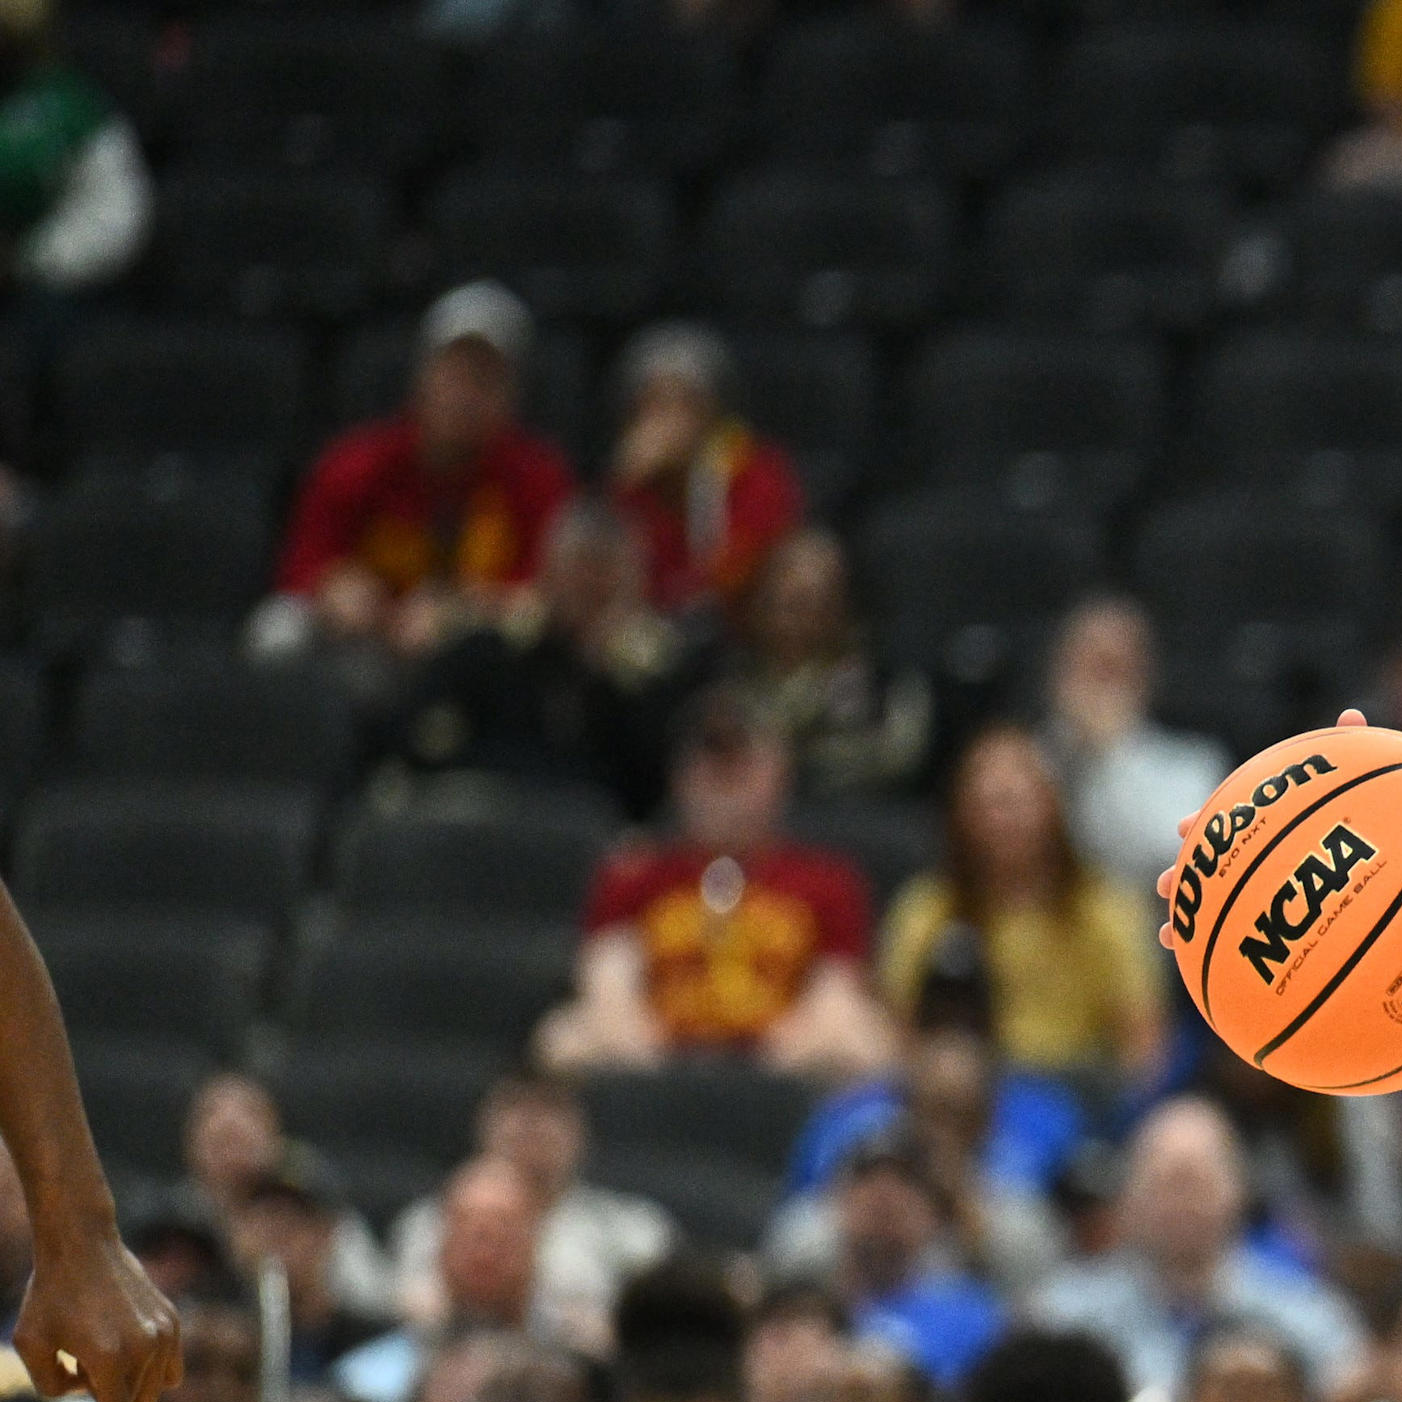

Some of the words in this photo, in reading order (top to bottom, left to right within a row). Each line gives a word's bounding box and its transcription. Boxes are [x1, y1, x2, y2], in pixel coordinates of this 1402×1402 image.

[1172, 754, 1339, 944] Wilson
[1218, 847, 1241, 878] EVO
[1242, 816, 1268, 846] NXT
[1238, 823, 1378, 986] NCAA
[1275, 940, 1319, 997] OFFICIAL
[1317, 894, 1354, 937] GAME
[1353, 860, 1388, 895] BALL
